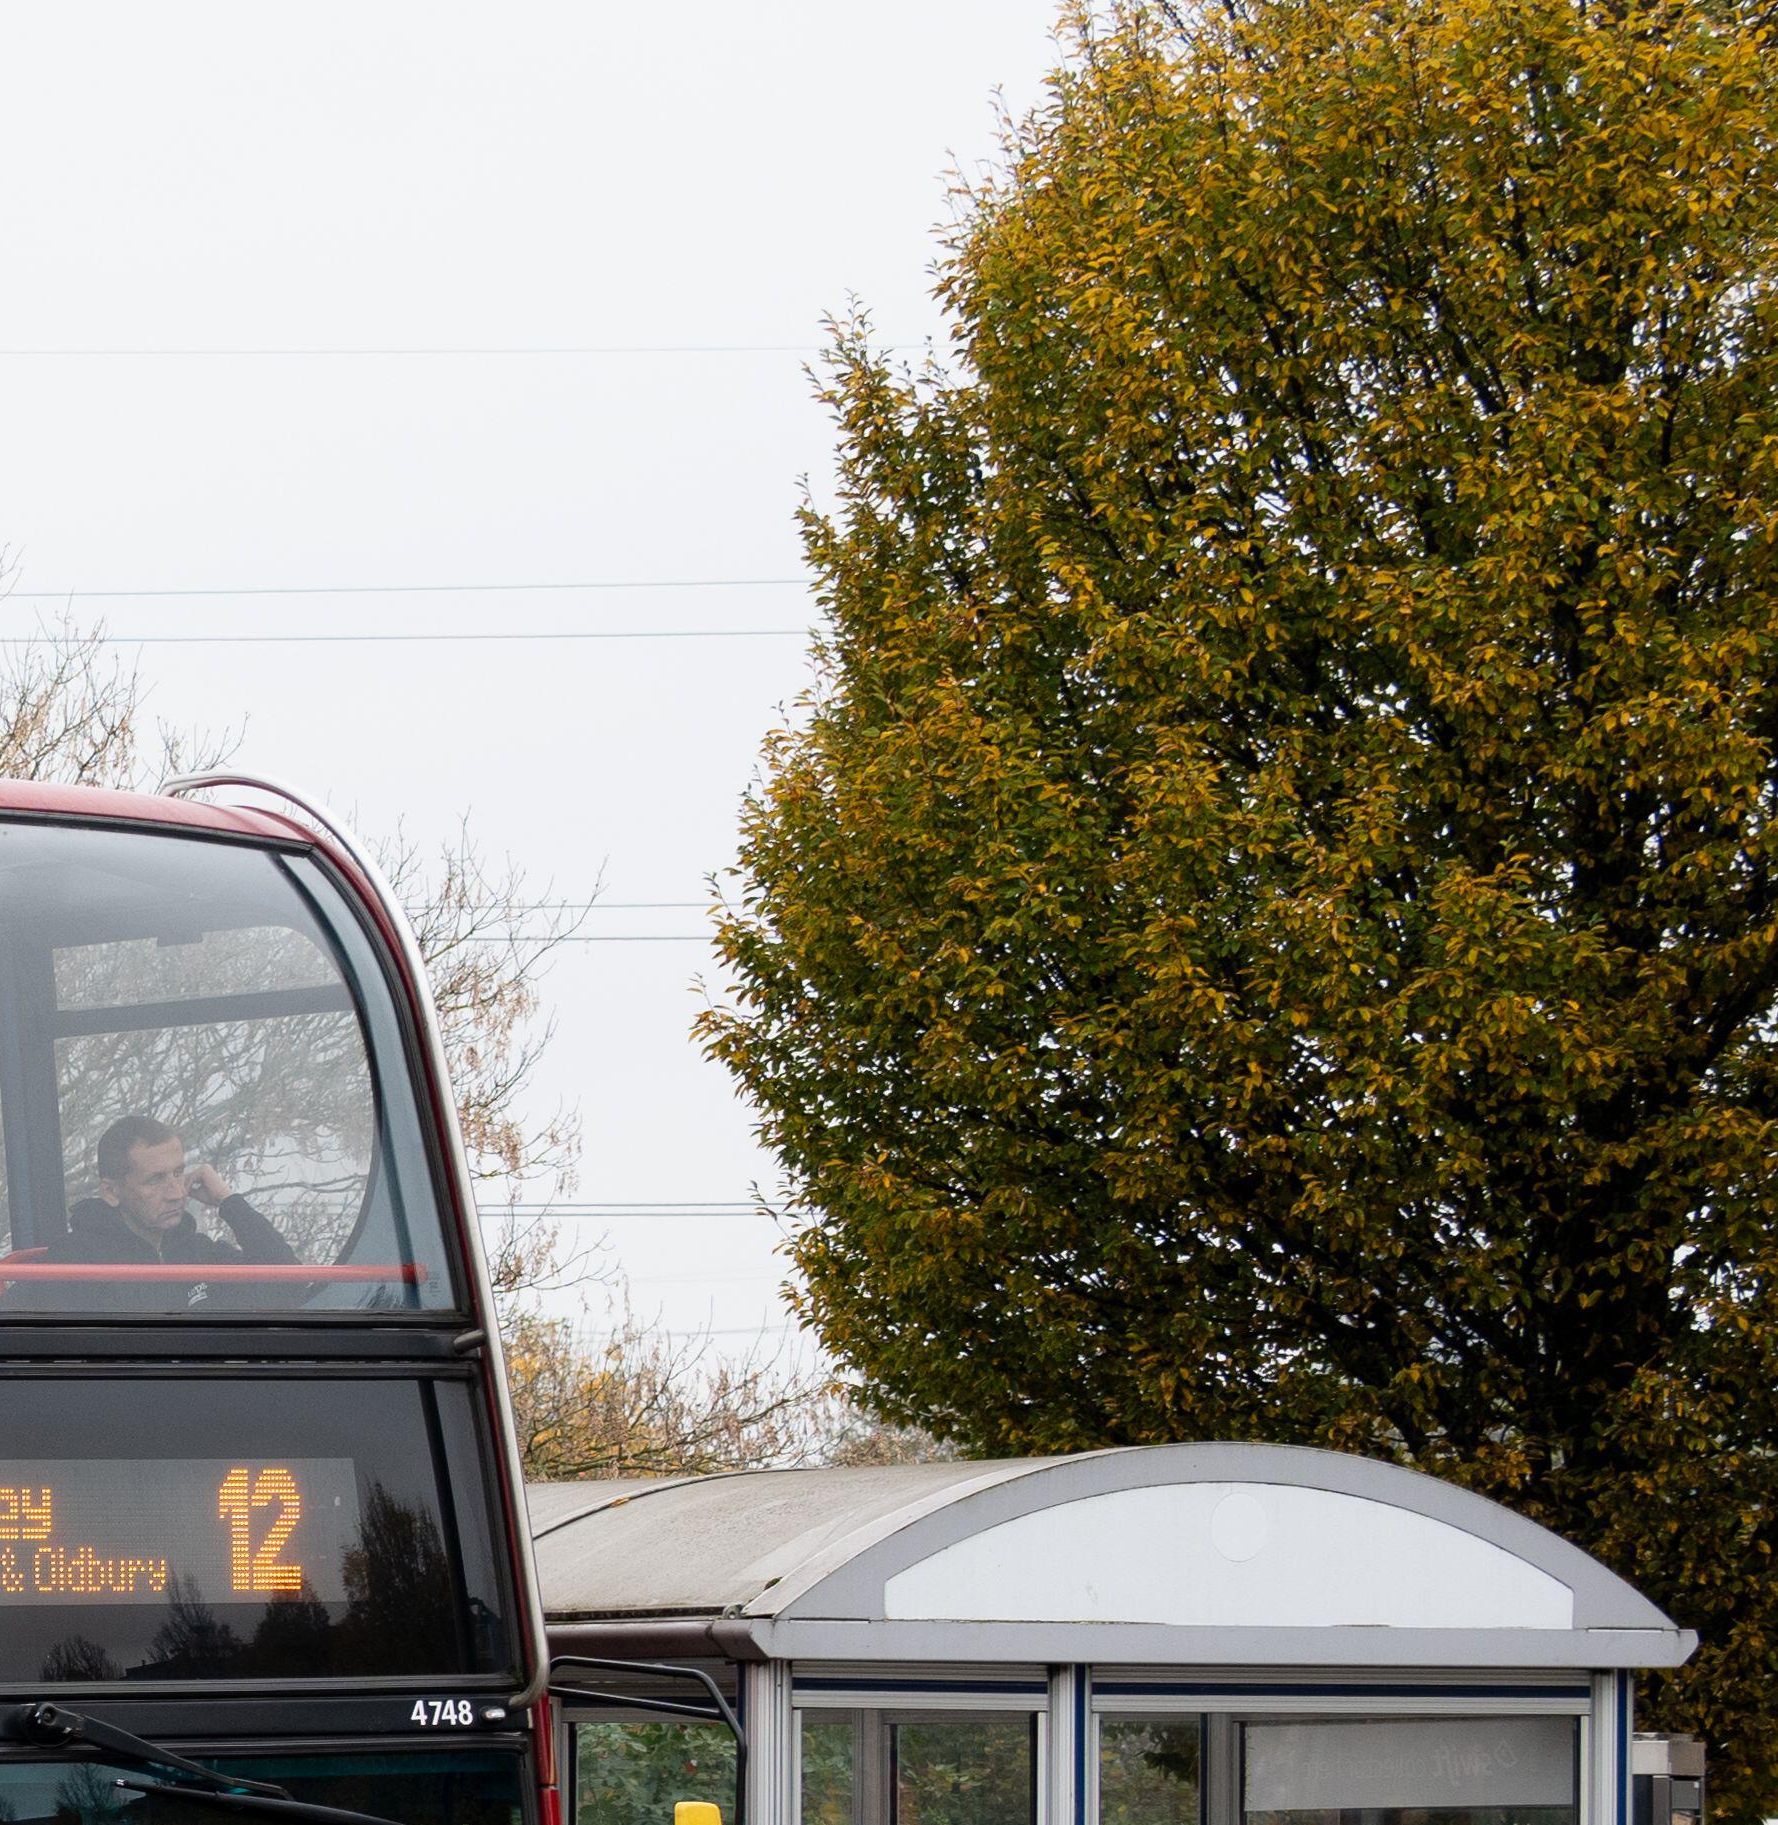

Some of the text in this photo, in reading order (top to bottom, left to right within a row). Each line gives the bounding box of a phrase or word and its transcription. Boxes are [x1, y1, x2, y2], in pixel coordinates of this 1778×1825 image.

[218, 1468, 302, 1591] 12
[0, 1546, 25, 1593] &
[33, 1546, 167, 1593] Oldbury
[410, 1699, 474, 1726] 4748
